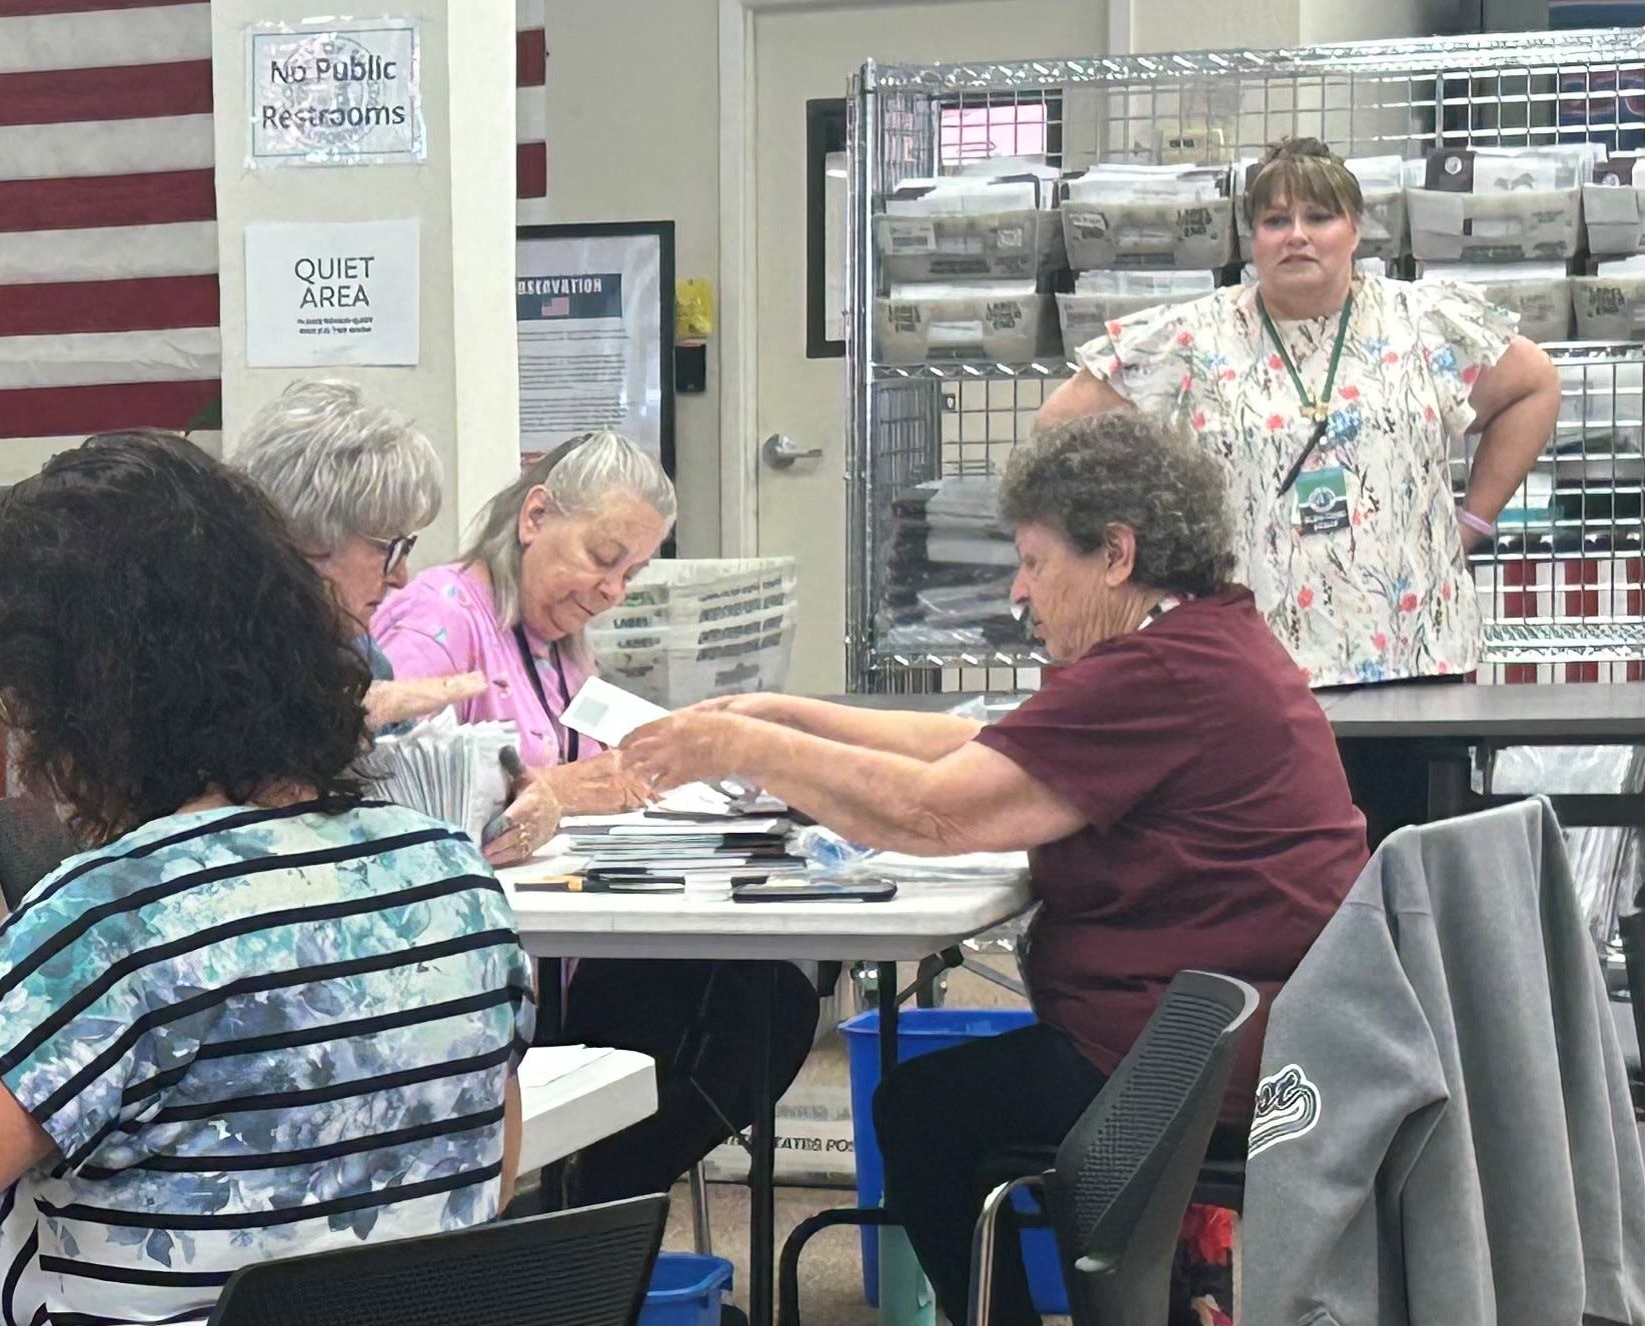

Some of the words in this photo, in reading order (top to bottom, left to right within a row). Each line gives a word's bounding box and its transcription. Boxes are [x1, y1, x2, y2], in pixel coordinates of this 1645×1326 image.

[271, 60, 306, 83] No
[316, 56, 397, 82] Public
[262, 106, 405, 129] Restrooms
[294, 256, 375, 284] QUIET
[300, 284, 370, 308] AREA
